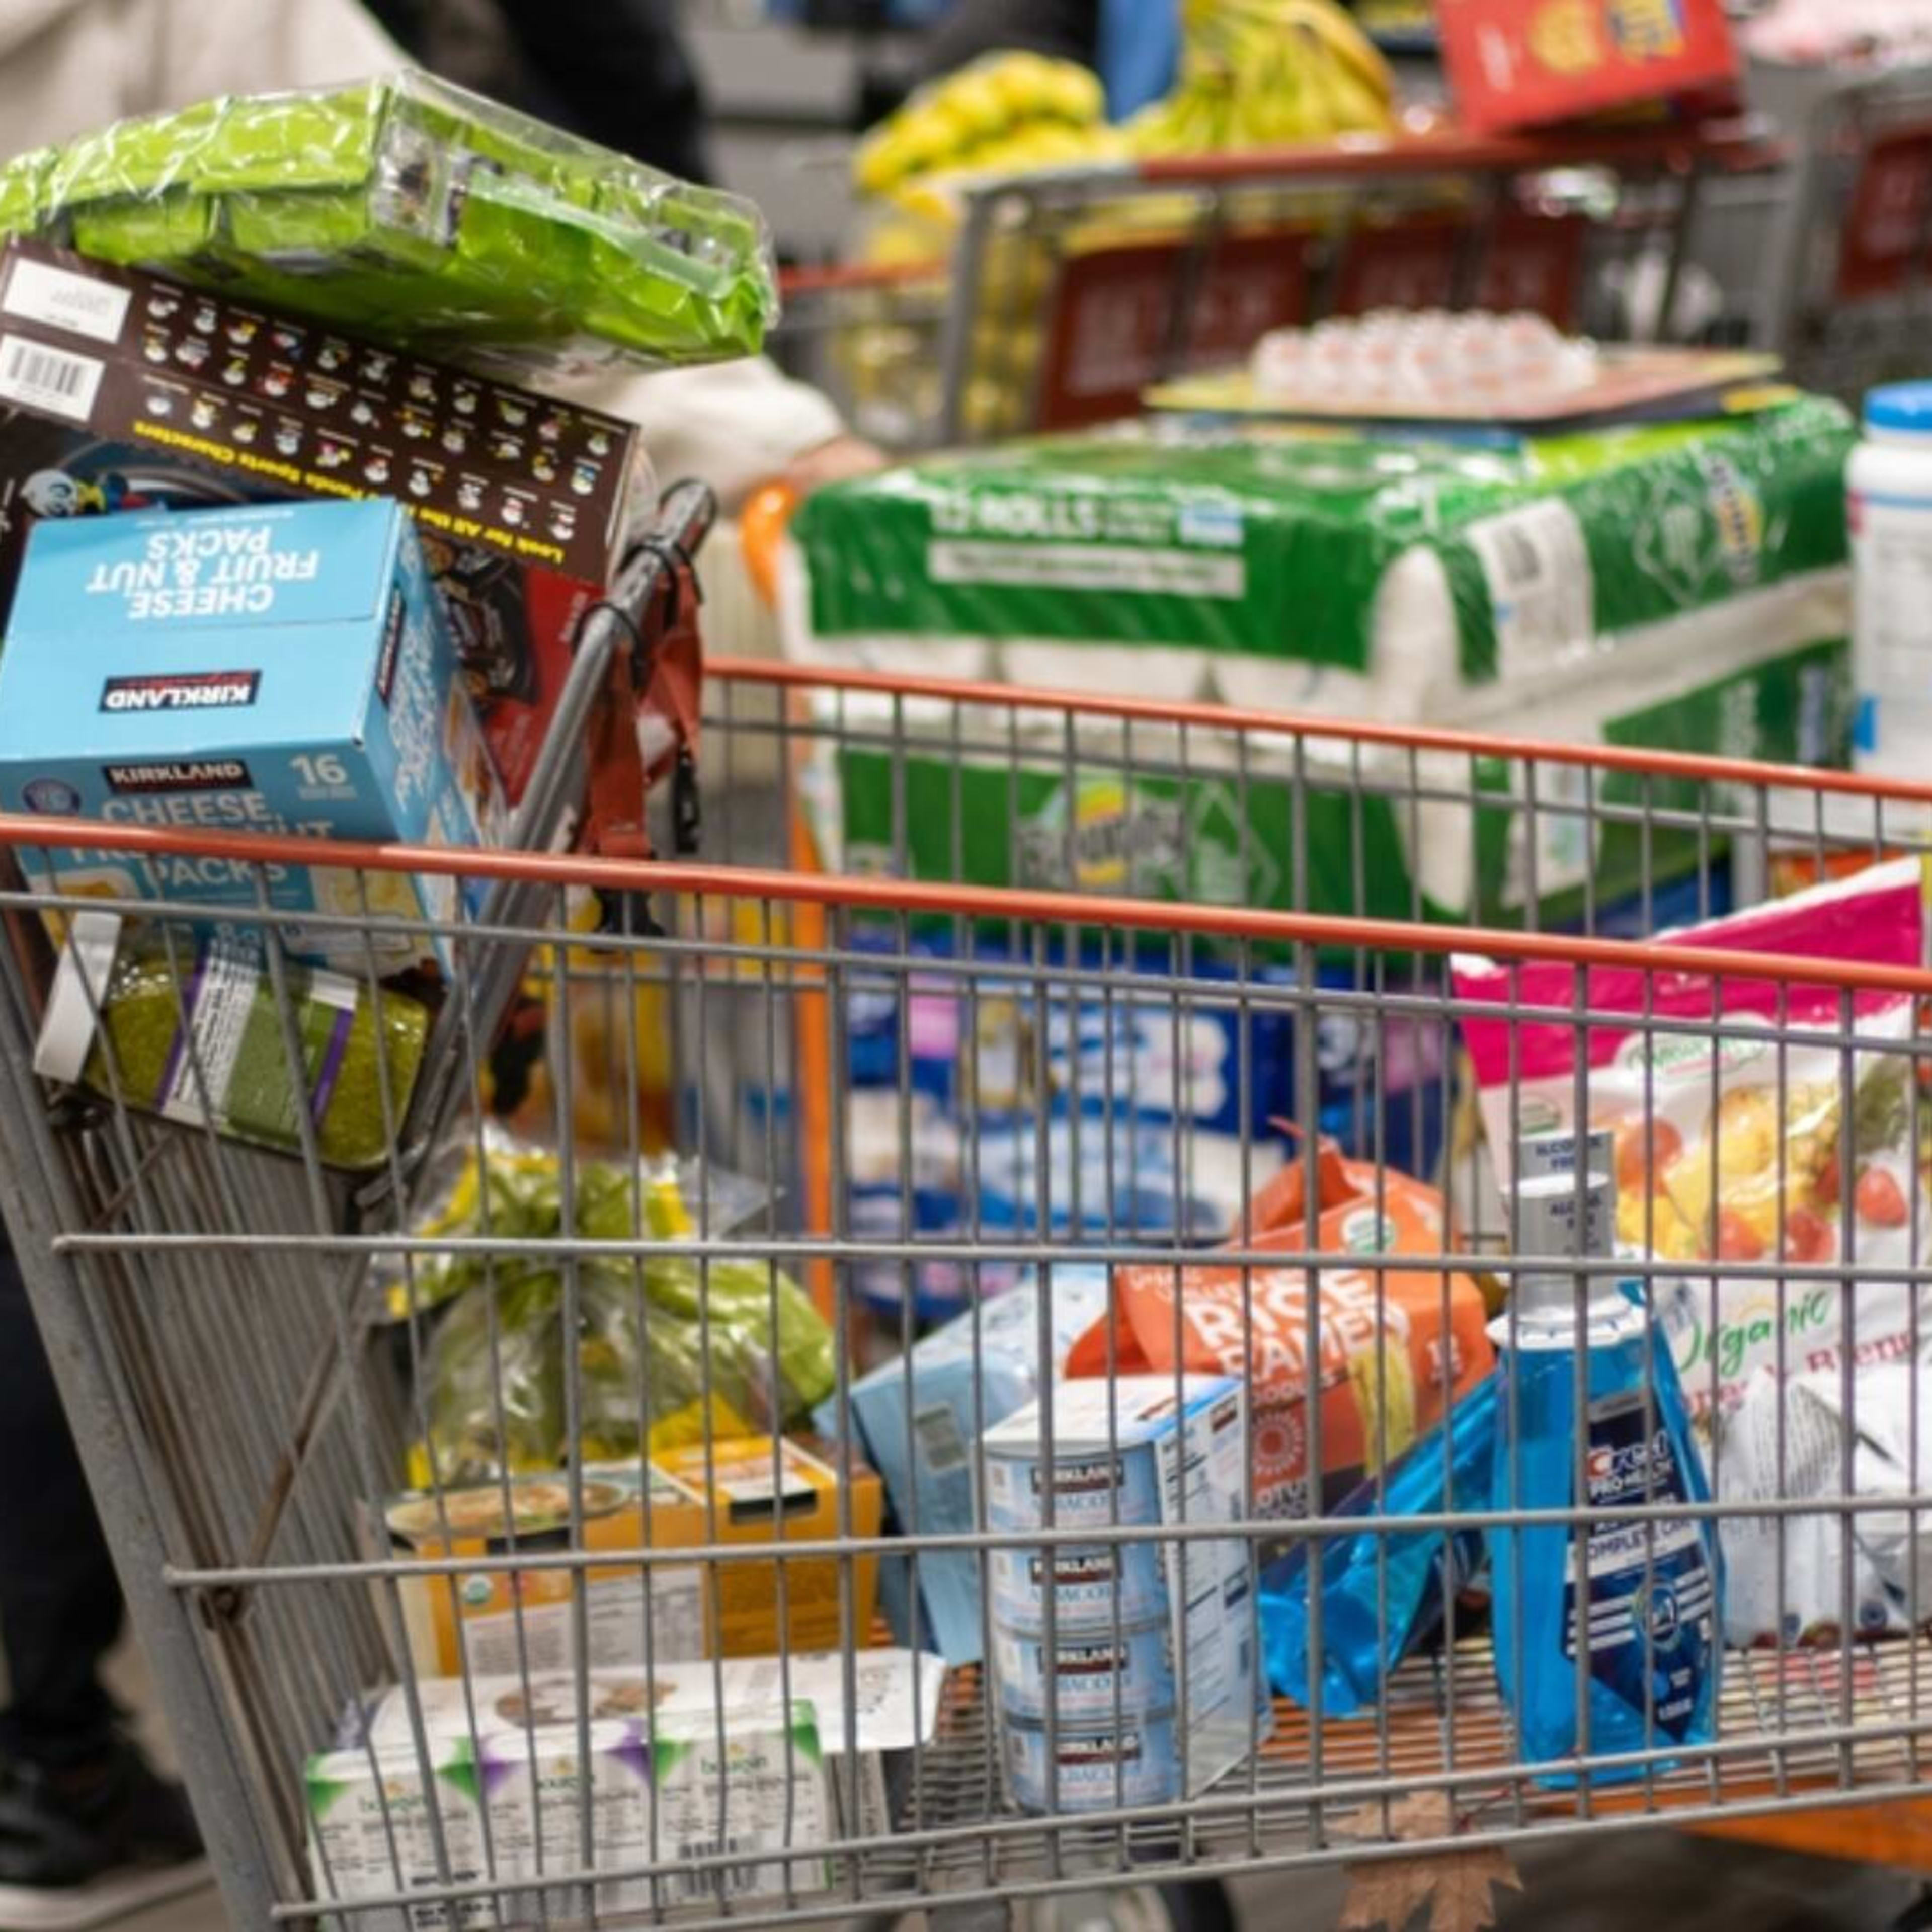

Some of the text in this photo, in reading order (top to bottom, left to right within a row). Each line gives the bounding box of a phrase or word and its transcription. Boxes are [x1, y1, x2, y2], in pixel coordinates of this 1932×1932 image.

[133, 420, 235, 464] Characters
[239, 453, 300, 484] Sports
[419, 507, 452, 529] the
[147, 526, 272, 559] PACKS
[484, 528, 514, 548] for
[86, 550, 319, 593] FRUIT & NUT
[106, 683, 251, 709] KIRKLAND
[109, 762, 244, 784] KIRKLAND
[290, 753, 347, 786] 16
[1183, 1267, 1375, 1348] RICE
